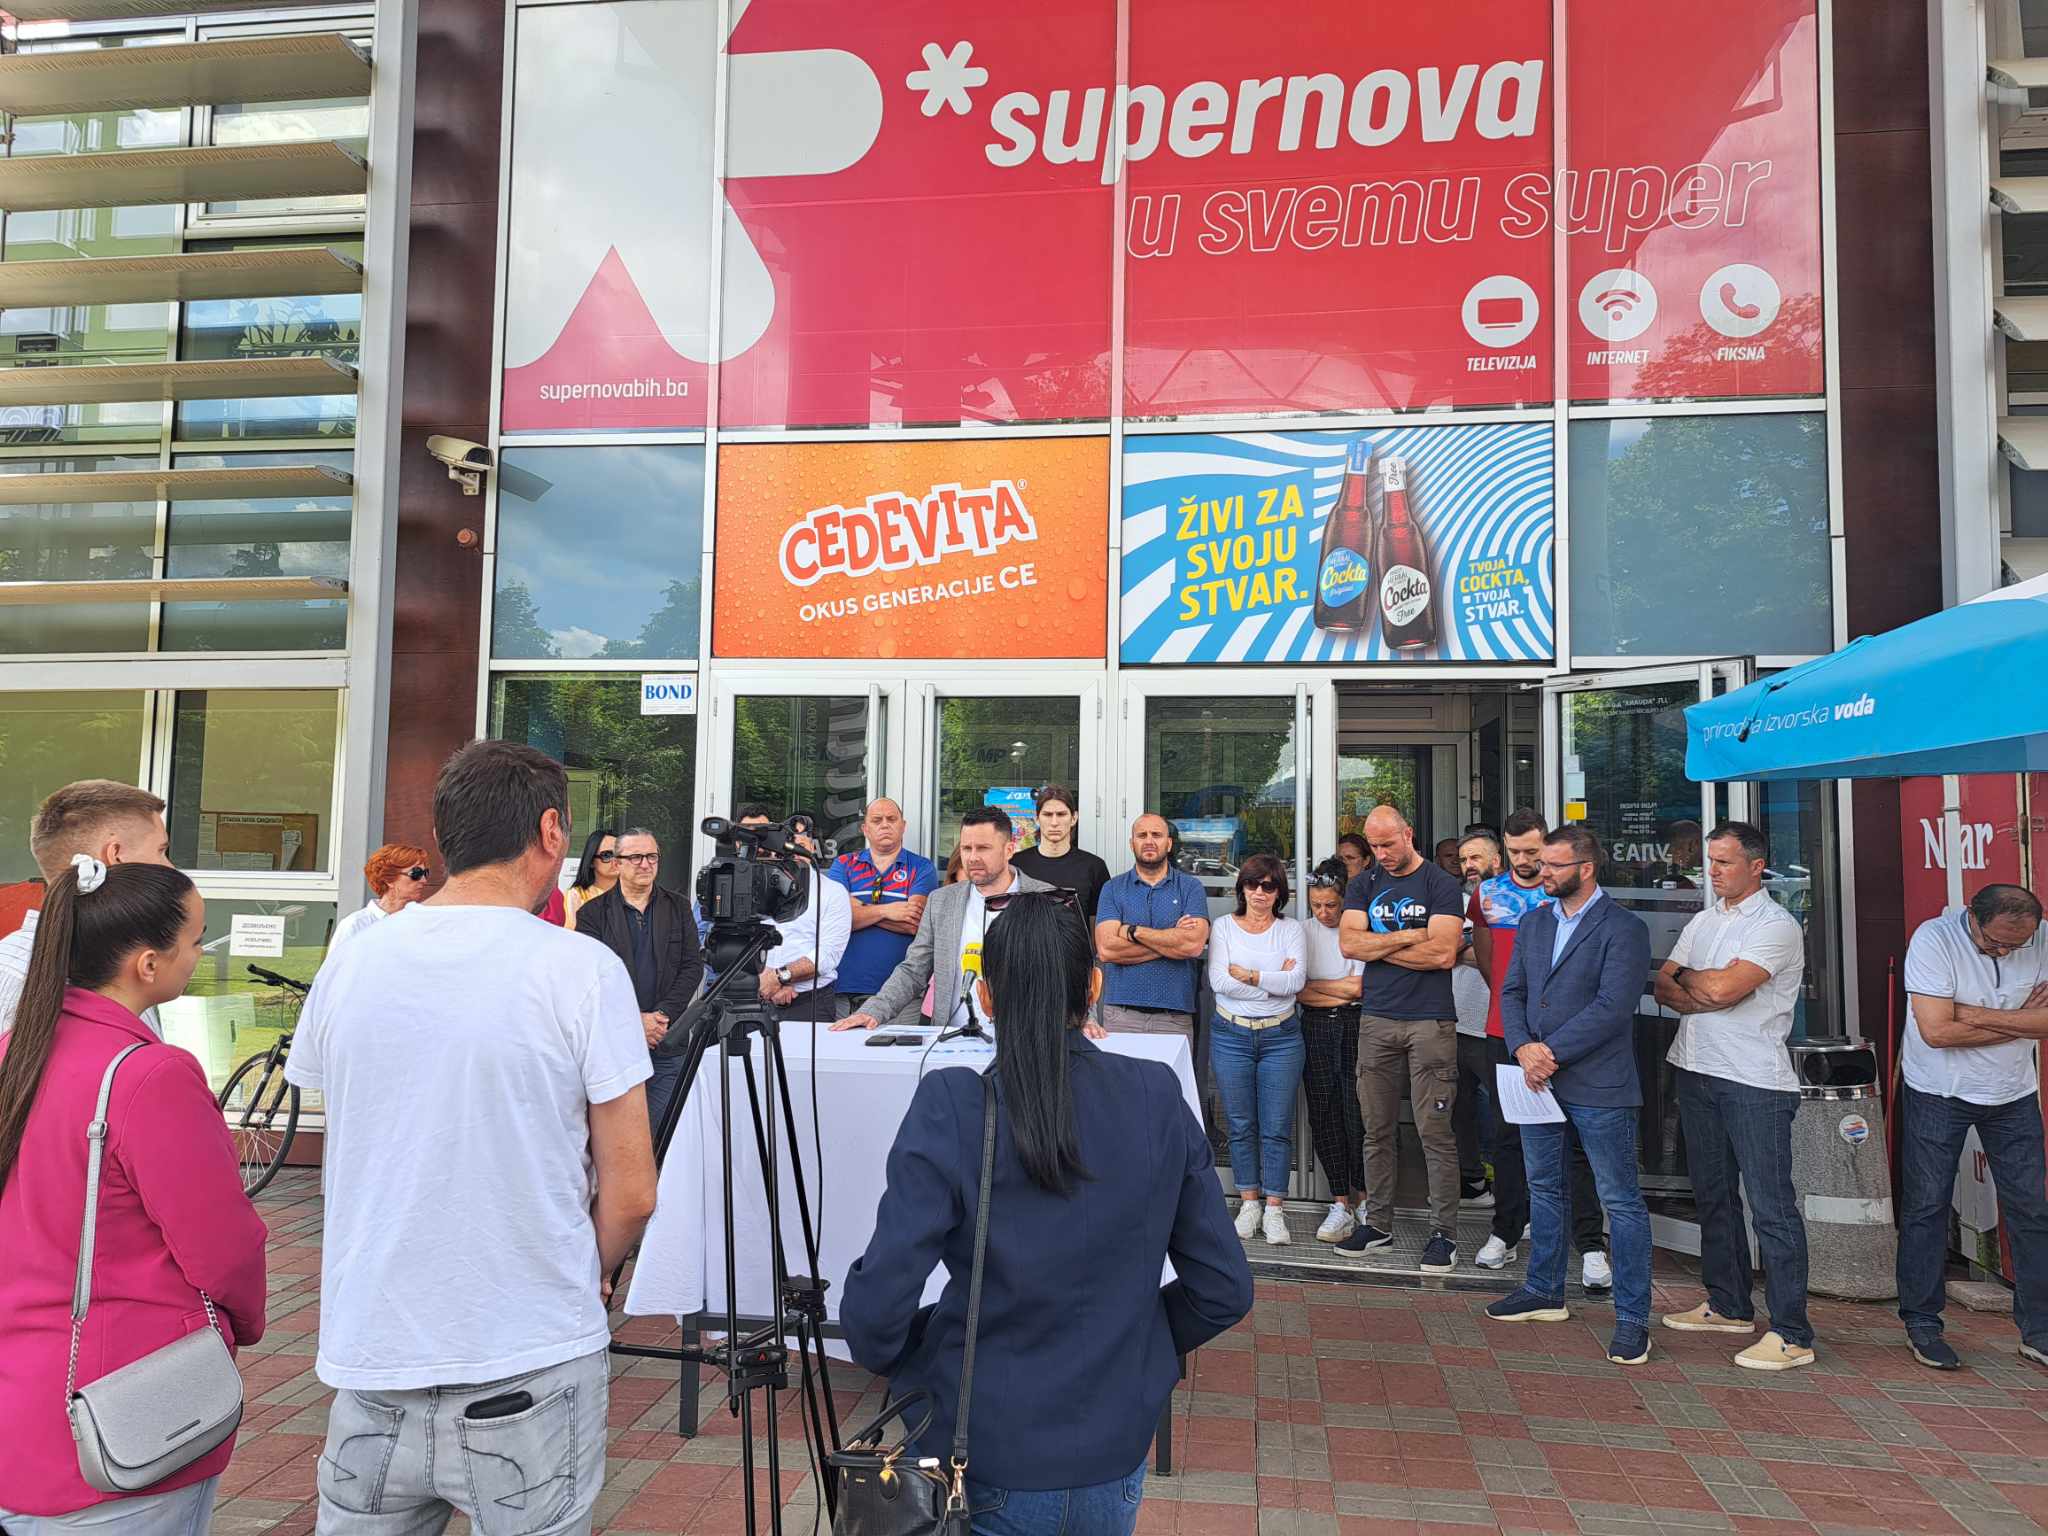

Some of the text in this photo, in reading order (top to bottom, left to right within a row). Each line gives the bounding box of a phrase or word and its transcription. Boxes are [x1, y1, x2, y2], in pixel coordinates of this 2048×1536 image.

[984, 59, 1544, 185] supernova
[1127, 158, 1772, 259] u svemu super
[1466, 355, 1536, 372] TELEVIZIJA
[1587, 349, 1649, 366] INTERNET
[1716, 346, 1766, 362] FIKSNA
[539, 377, 689, 404] supernovabih.ba
[1176, 484, 1305, 541] ŽIVI ZA
[782, 483, 1034, 583] CEDEVITA
[1186, 525, 1297, 580] SVOJU
[1469, 558, 1506, 574] TVOJA
[1320, 560, 1368, 591] Cockta
[1460, 568, 1530, 594] COCKTA,
[799, 562, 1038, 622] OKUS GENERACIJE CE
[1180, 567, 1309, 621] STVAR.
[1383, 577, 1429, 611] Cockta
[1473, 588, 1512, 604] TVOJA
[1464, 599, 1525, 624] STVAR.
[645, 684, 693, 700] BOND
[1702, 693, 1876, 748] priroda izvorska voda
